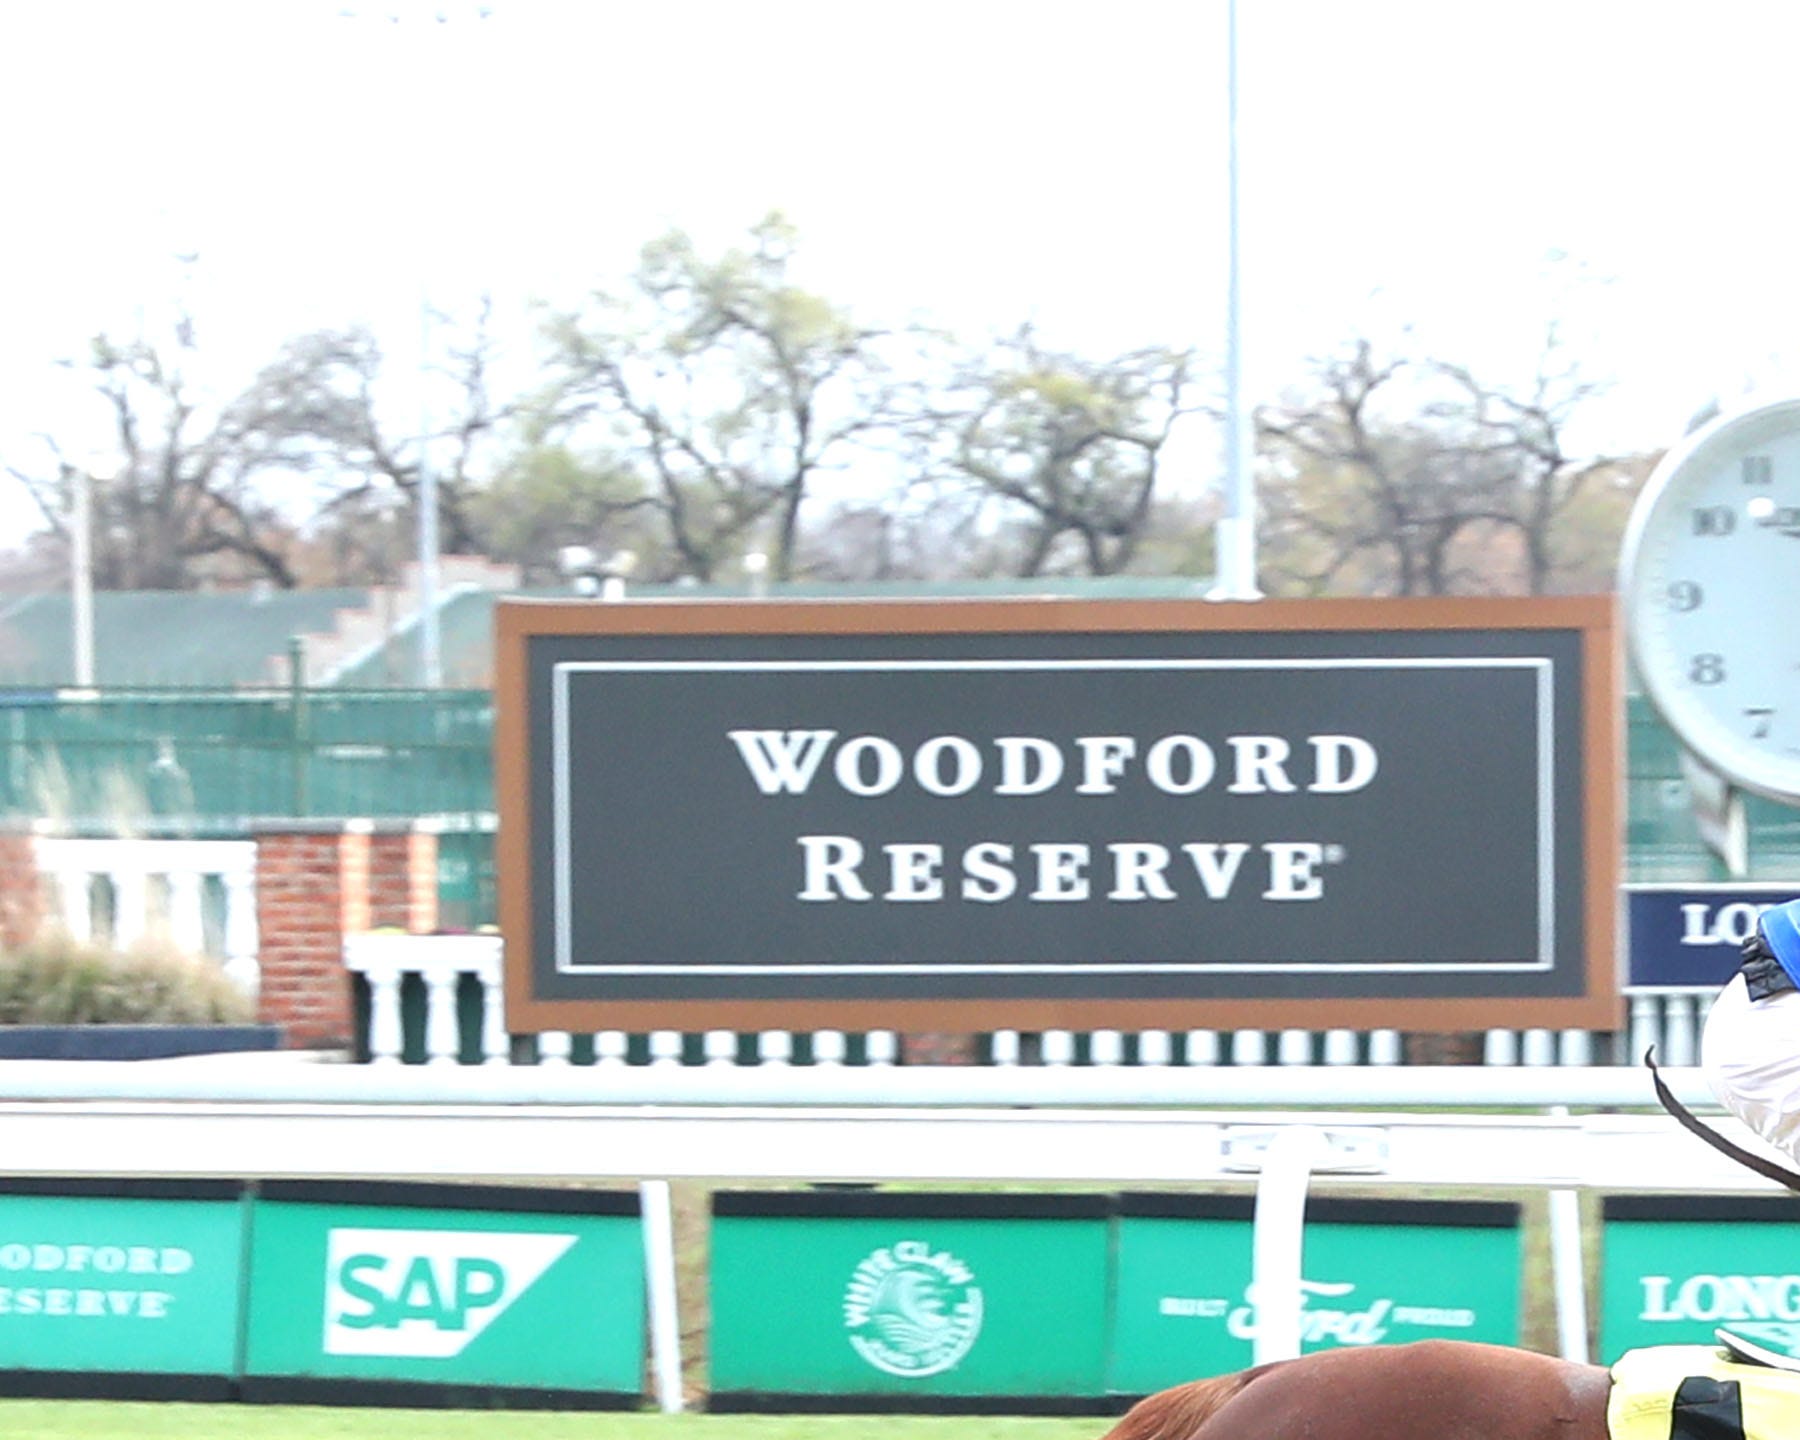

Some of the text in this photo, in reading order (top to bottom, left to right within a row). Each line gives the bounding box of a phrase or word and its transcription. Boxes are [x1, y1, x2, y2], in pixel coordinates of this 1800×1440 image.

[1667, 580, 1704, 612] 9
[1689, 653, 1727, 686] 8
[1742, 707, 1777, 740] 7
[726, 729, 1379, 796] WOODFORD
[338, 1253, 506, 1331] SAP
